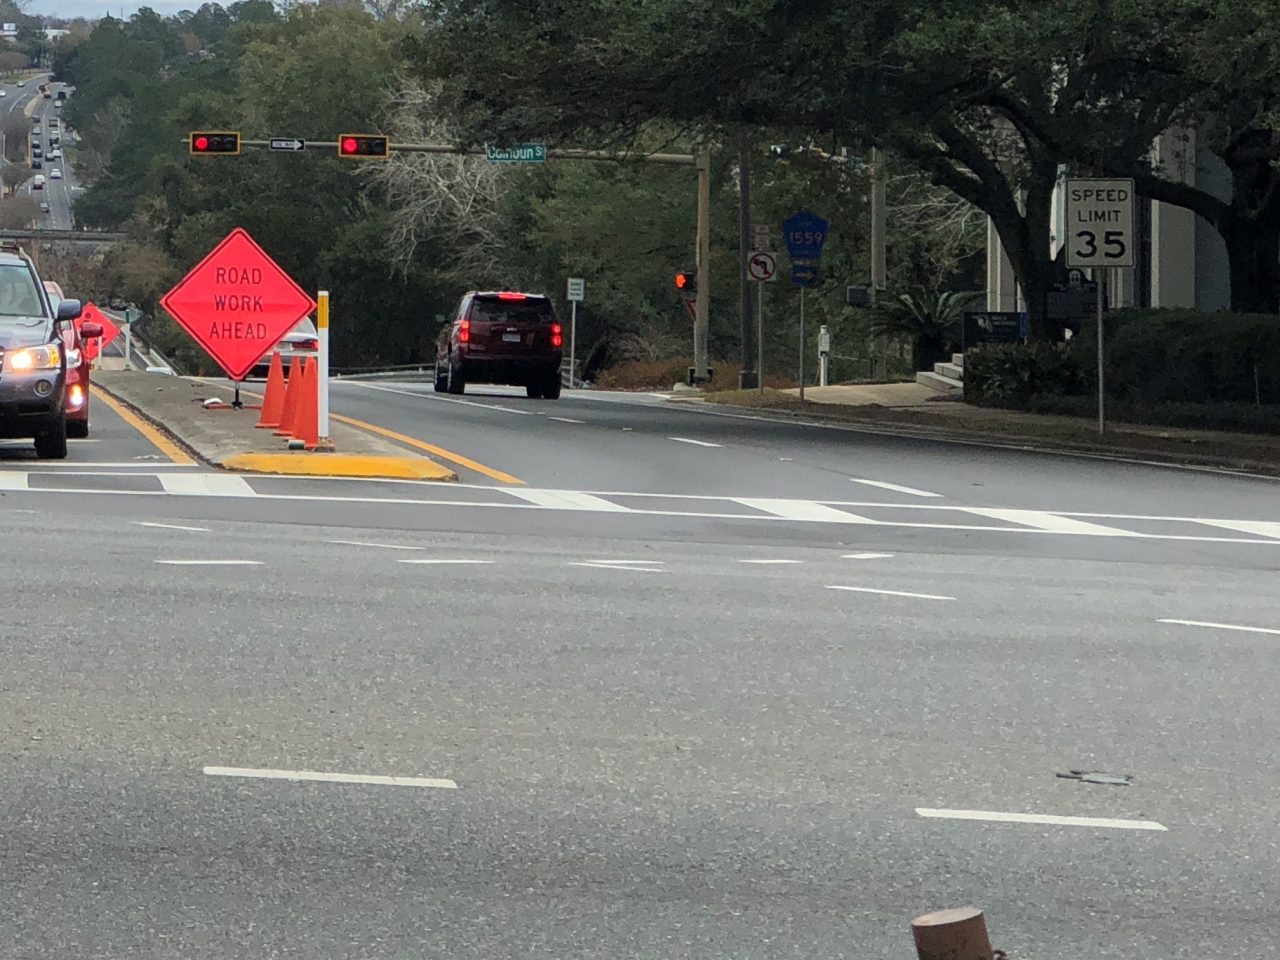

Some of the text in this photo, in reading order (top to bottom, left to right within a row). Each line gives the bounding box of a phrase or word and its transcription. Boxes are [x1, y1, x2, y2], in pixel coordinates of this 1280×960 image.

[1072, 189, 1128, 202] SPEED
[1077, 210, 1121, 222] LIMIT
[1075, 230, 1126, 258] 35
[216, 266, 262, 285] ROAD
[214, 294, 263, 312] WORK
[209, 321, 267, 340] AHEAD
